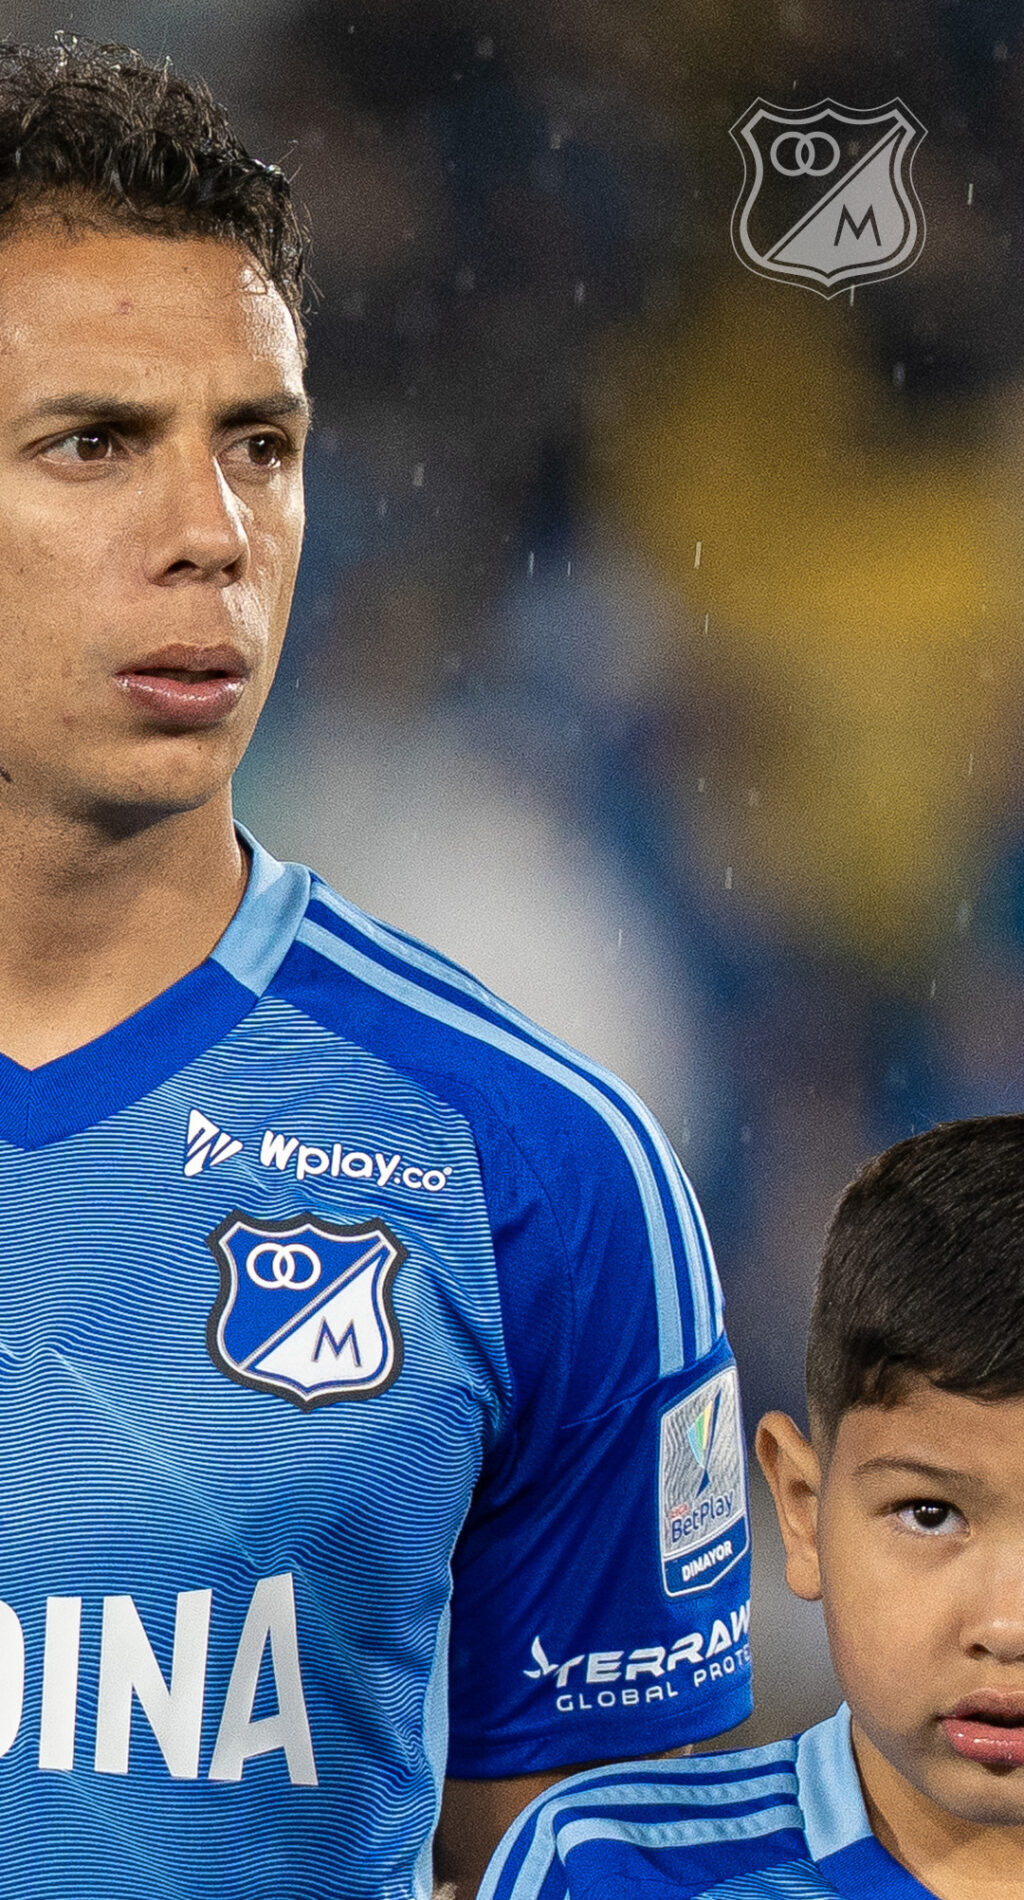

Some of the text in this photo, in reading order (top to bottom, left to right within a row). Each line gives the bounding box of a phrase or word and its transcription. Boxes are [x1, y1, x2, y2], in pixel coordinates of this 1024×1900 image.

[311, 1319, 362, 1368] M
[671, 1490, 734, 1543] BetPlay
[681, 1540, 733, 1582] DIMAYOR
[556, 1681, 678, 1712] GLOBAL
